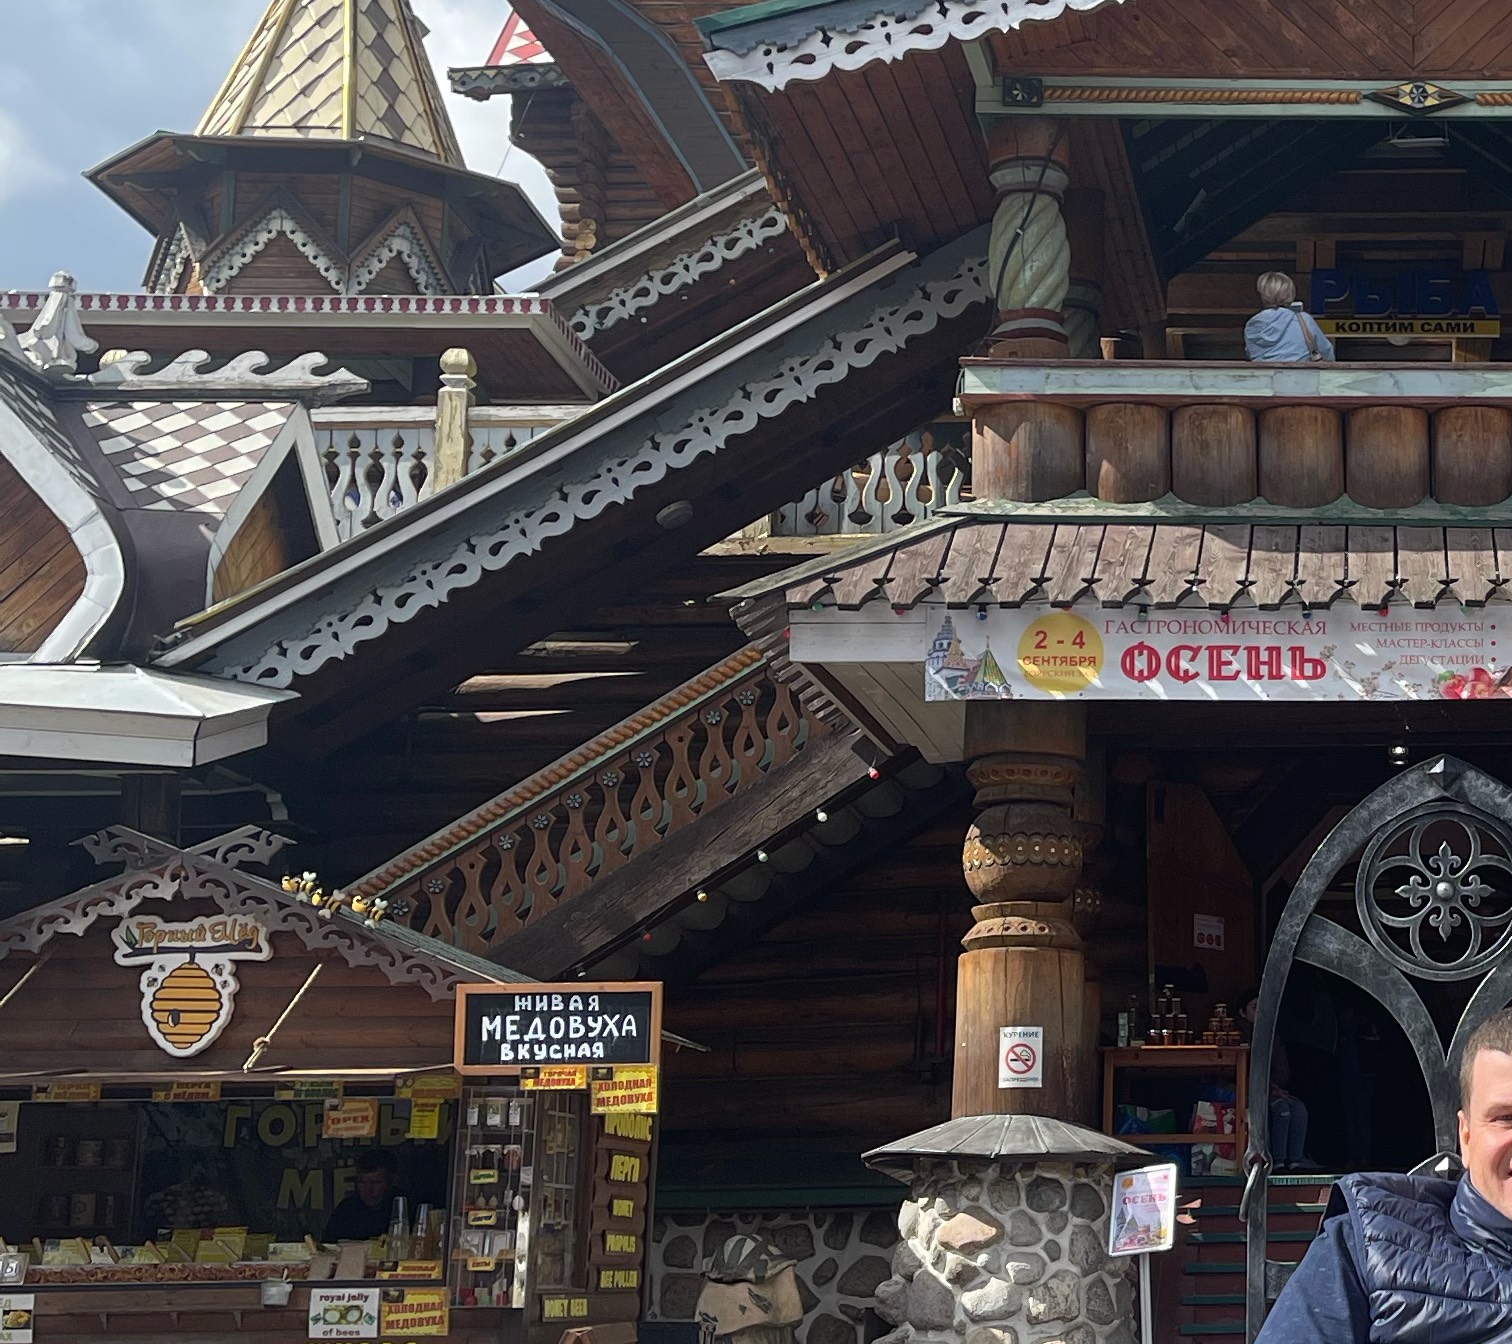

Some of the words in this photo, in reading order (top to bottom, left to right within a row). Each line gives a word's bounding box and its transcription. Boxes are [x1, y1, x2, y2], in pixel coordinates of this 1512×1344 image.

[1310, 268, 1499, 318] РЫБА
[1335, 322, 1414, 333] КОПТИМ
[1421, 321, 1475, 333] САМИ
[1105, 619, 1327, 636] ГАСТРОНОМИЧЕСКАЯ
[1351, 622, 1412, 632] МЕСТНЫЕ
[1415, 622, 1484, 633] ПРОДУКТЫ
[1034, 630, 1048, 649] 2
[1071, 630, 1086, 649] 4
[1376, 639, 1484, 648] МАСТЕР-КЛАССЫ
[1023, 656, 1097, 667] СЕНТЯБРЯ
[1120, 641, 1327, 684] ОСЕНЬ
[514, 994, 600, 1012] ЖИВАЯ
[481, 1014, 638, 1042] МЕДОВУХА
[500, 1042, 605, 1061] ВКУСНАЯ
[597, 1078, 652, 1092] ХОЛОДНАЯ
[596, 1092, 653, 1108] МЕДОВУХА
[1122, 1193, 1167, 1205] ОСЕНЬ
[319, 1293, 345, 1303] royal
[346, 1292, 370, 1303] jelly
[386, 1315, 445, 1330] МЕДОВУХА
[322, 1328, 333, 1336] of
